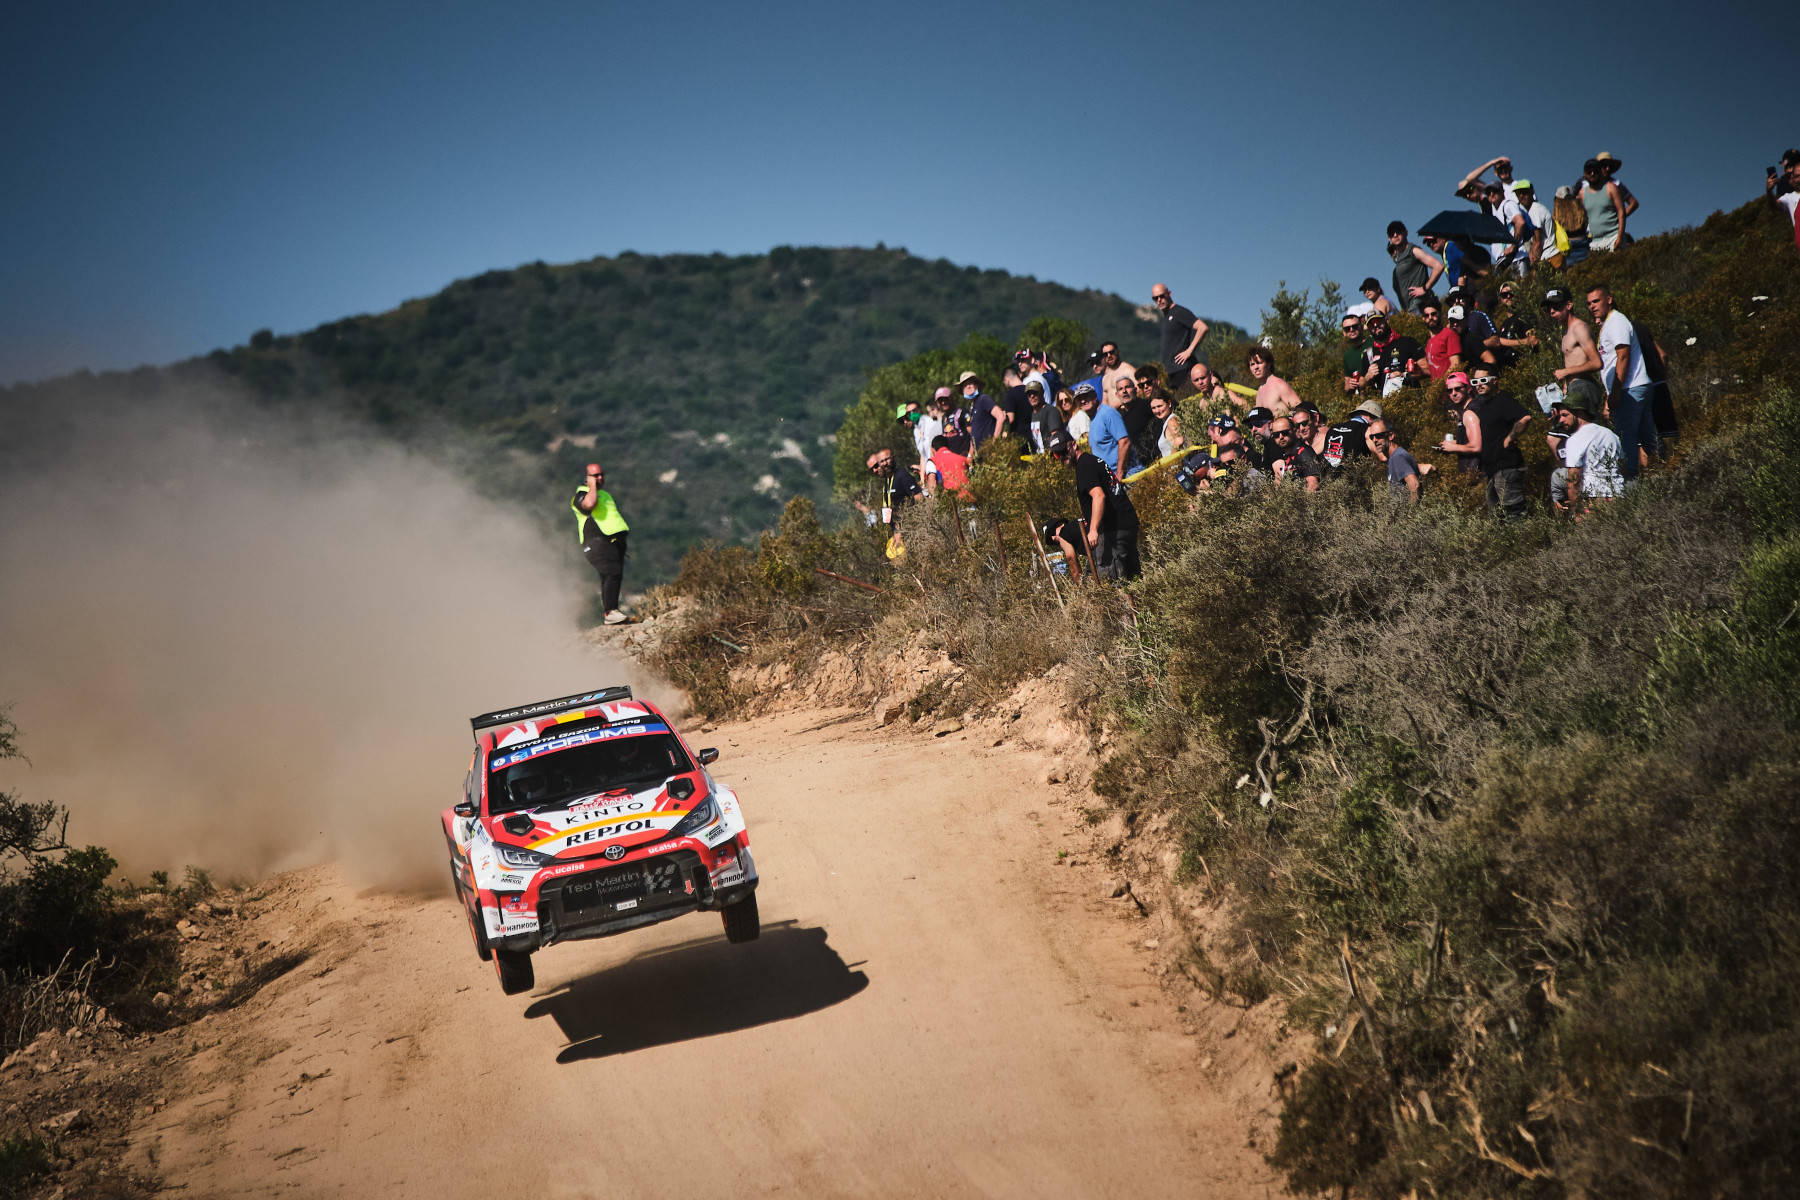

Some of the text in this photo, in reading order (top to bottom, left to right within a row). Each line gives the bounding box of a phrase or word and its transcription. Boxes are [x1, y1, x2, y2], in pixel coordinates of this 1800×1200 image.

[493, 711, 519, 720] Teo
[510, 734, 556, 751] TOYOTA
[532, 725, 647, 755] FORUM8
[566, 819, 655, 847] REPSOL
[648, 842, 678, 854] ucalsa
[555, 863, 585, 874] ucalsa
